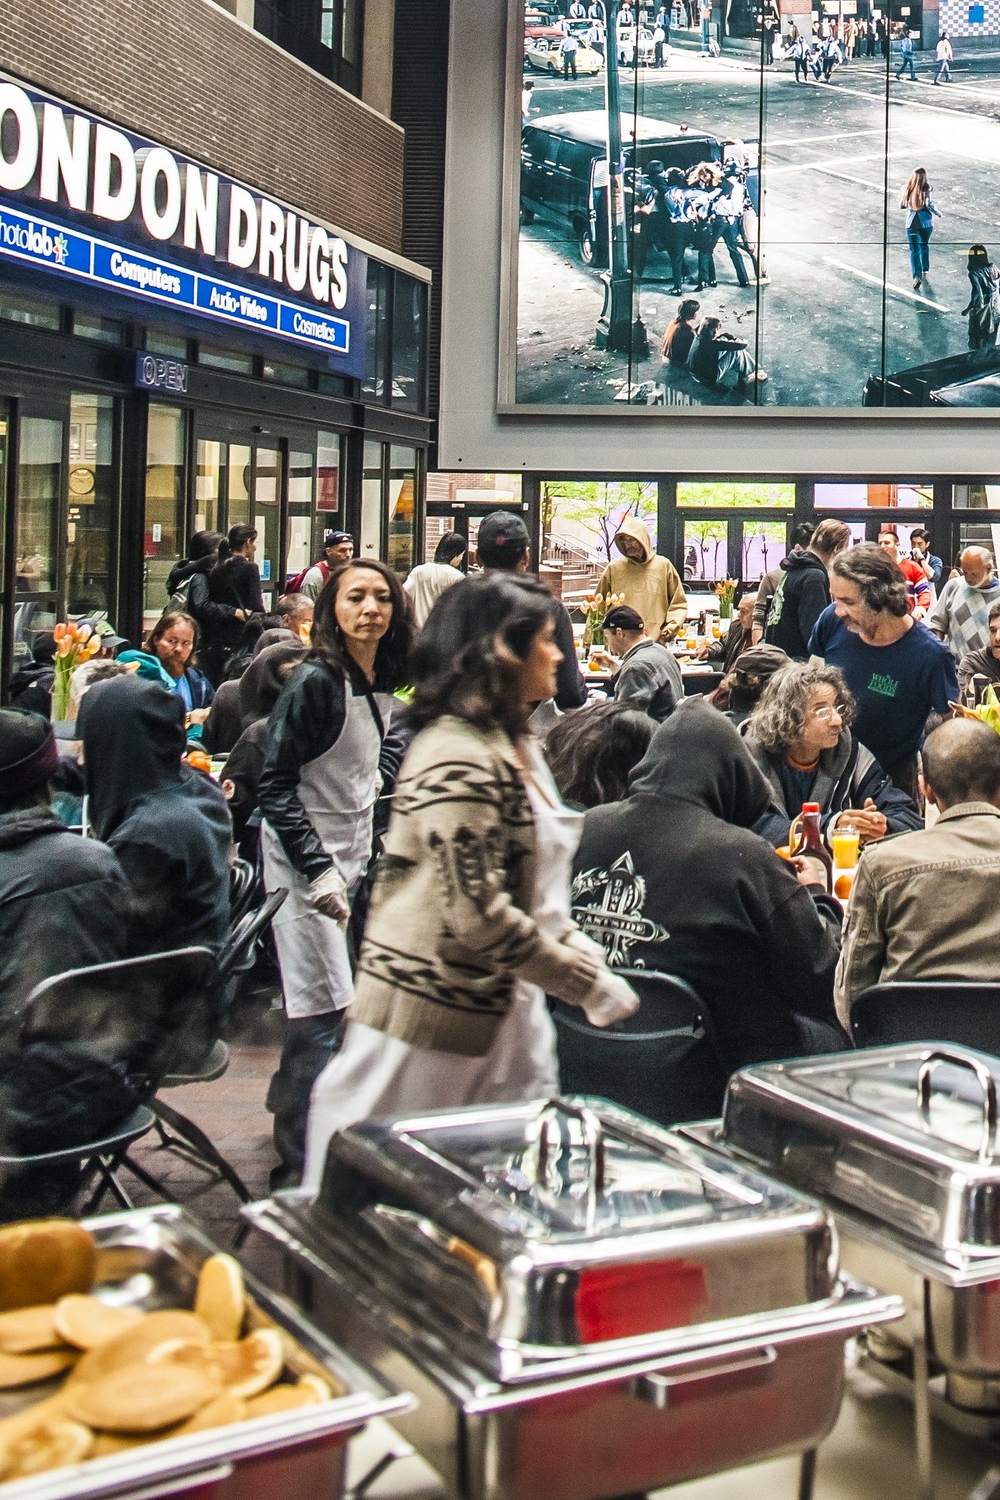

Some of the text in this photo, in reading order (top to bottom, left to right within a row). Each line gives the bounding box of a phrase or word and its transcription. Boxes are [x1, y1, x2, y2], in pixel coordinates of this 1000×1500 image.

[228, 183, 349, 310] DRUGS
[110, 252, 182, 294] Computers
[293, 312, 336, 343] Cosmetics
[143, 356, 188, 393] OPEN
[872, 673, 899, 687] WHOLE
